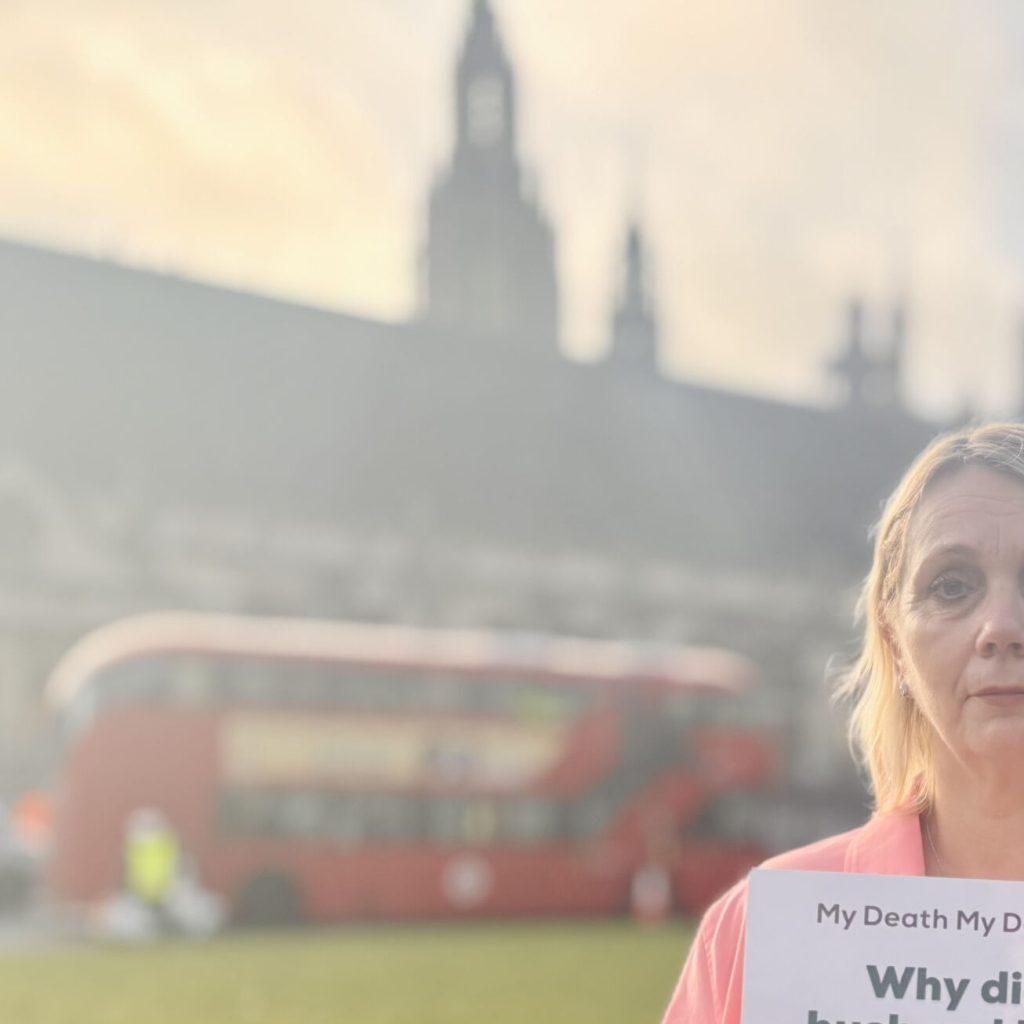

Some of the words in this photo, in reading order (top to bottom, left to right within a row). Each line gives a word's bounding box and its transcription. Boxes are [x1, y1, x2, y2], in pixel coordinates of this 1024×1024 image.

[816, 902, 858, 931] My
[863, 905, 948, 930] Death
[956, 909, 996, 938] My
[865, 964, 971, 1012] Why
